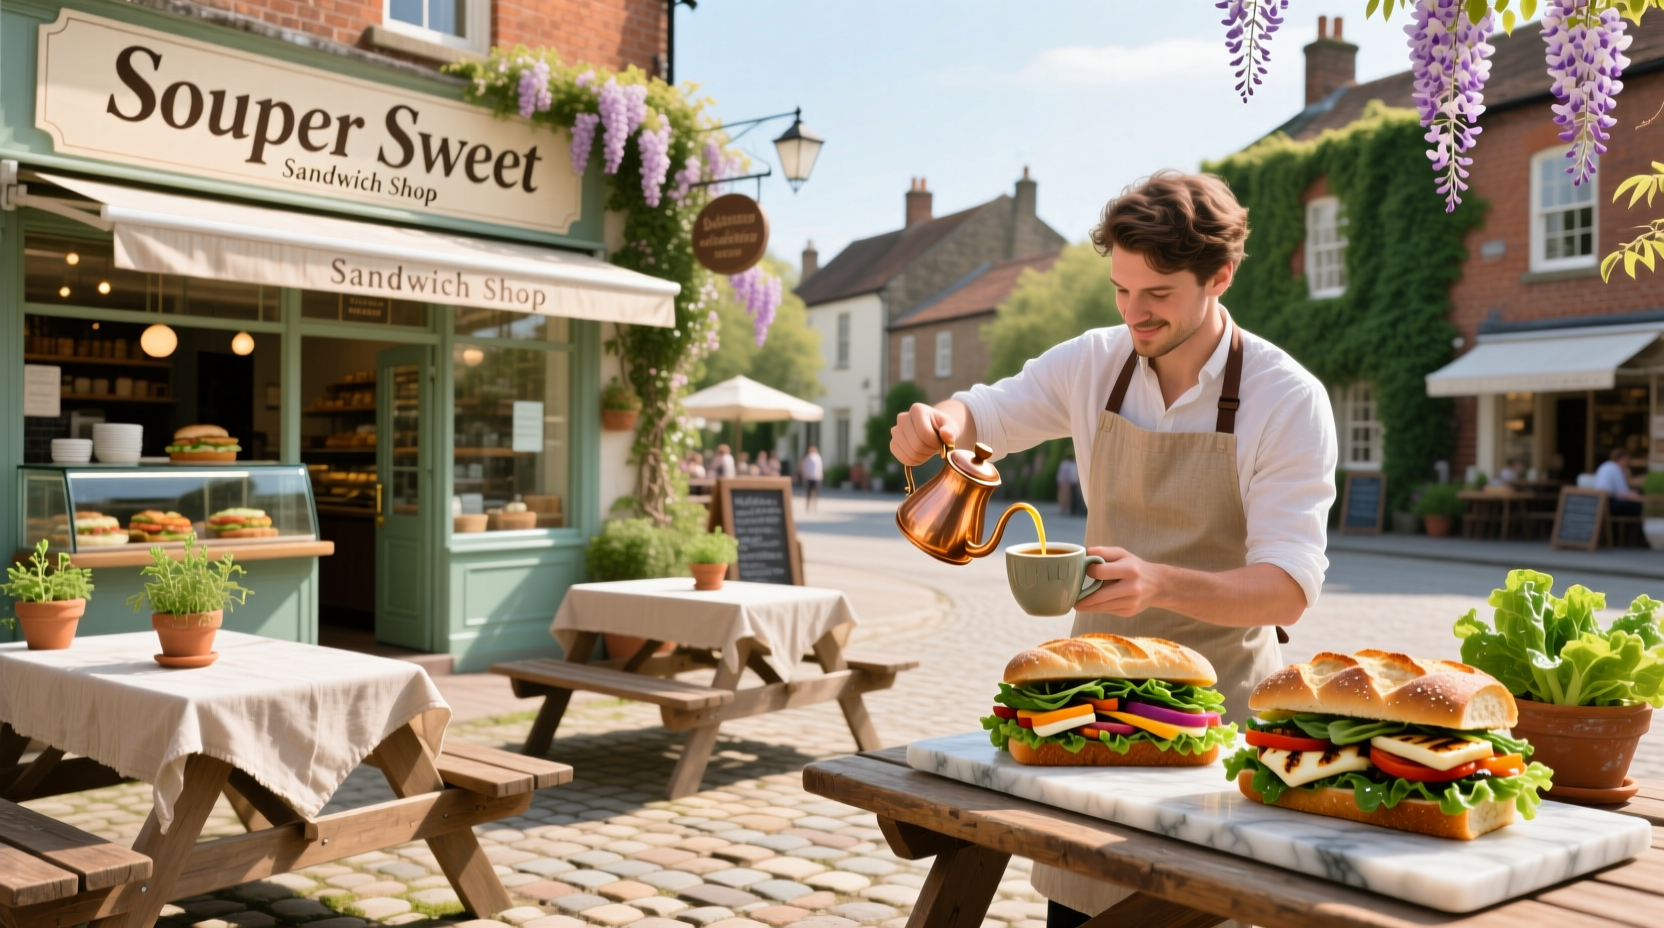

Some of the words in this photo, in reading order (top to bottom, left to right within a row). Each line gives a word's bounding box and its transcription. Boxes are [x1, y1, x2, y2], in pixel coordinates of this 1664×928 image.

[106, 45, 365, 165] Souper
[377, 104, 543, 194] Sweet
[281, 157, 383, 194] Sandwich
[388, 176, 439, 207] Shop
[330, 257, 471, 299] Sandwich
[483, 277, 547, 311] Shop
